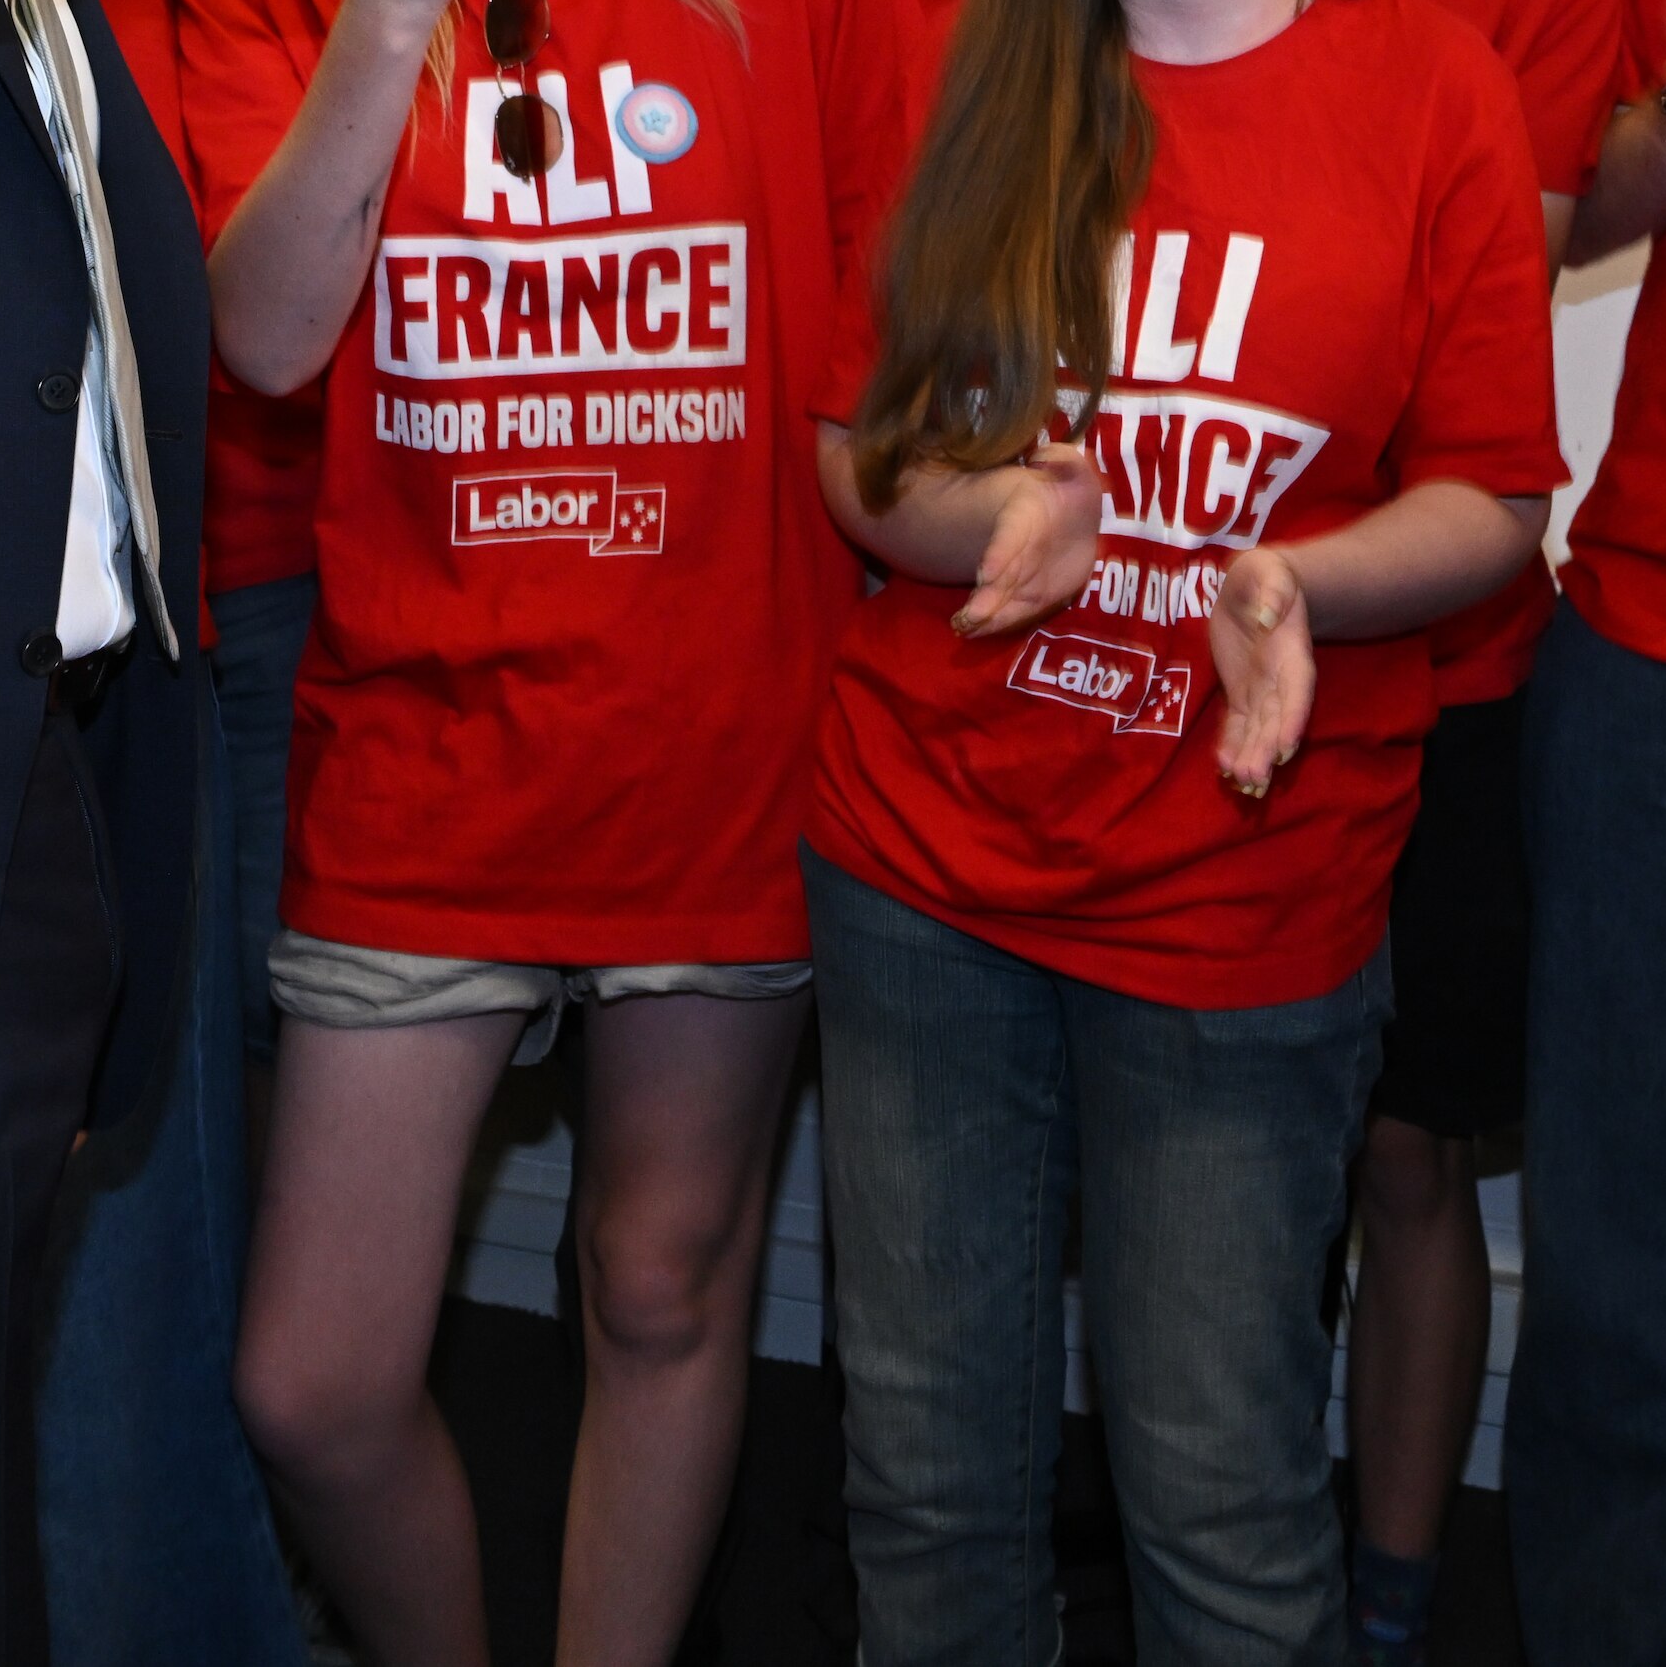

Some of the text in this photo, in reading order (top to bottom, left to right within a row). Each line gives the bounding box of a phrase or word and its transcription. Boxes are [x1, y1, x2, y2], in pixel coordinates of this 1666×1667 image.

[463, 61, 653, 226] ALI
[385, 243, 731, 365] FRANCE
[375, 388, 746, 453] LABOR FOR DICKSON
[1049, 411, 1303, 537] ANCE
[469, 485, 598, 532] Labor
[1079, 559, 1227, 627] FOR DICKS
[1028, 645, 1133, 701] Labor
